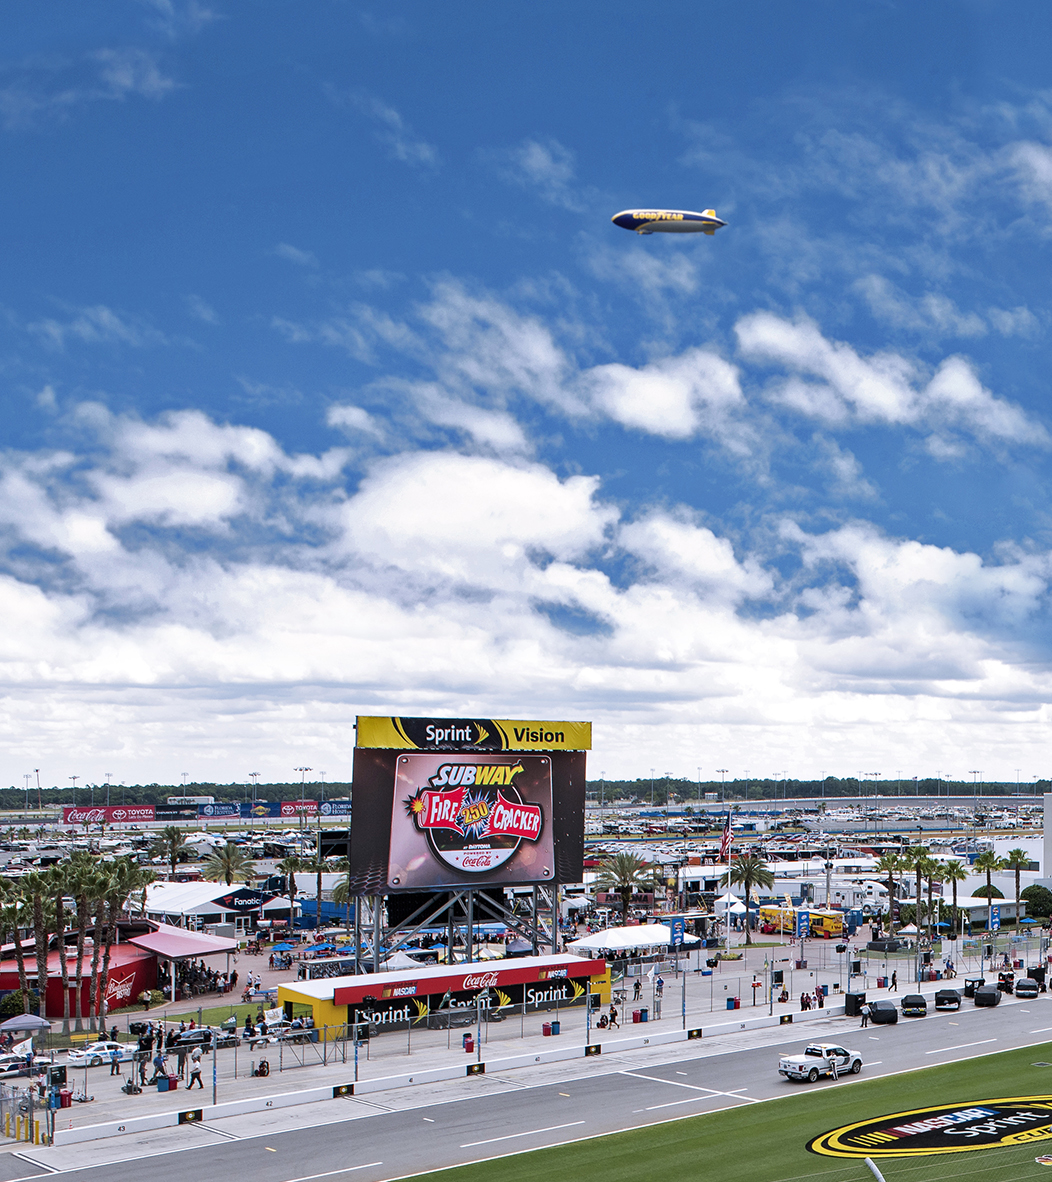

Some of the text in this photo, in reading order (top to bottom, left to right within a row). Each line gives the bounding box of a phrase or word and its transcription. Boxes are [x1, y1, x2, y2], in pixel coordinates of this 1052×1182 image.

[425, 725, 565, 743] Sprint Vision
[432, 765, 524, 786] SUBWAY
[127, 808, 154, 816] TOYOTA
[429, 795, 458, 824] FIRE
[461, 801, 489, 824] 250
[493, 804, 540, 832] CRACKER
[393, 985, 417, 997] NASCAR
[527, 984, 568, 1008] Sprint
[117, 1125, 126, 1133] 43
[893, 1107, 993, 1136] NASCAR
[943, 1109, 1051, 1139] Sprint
